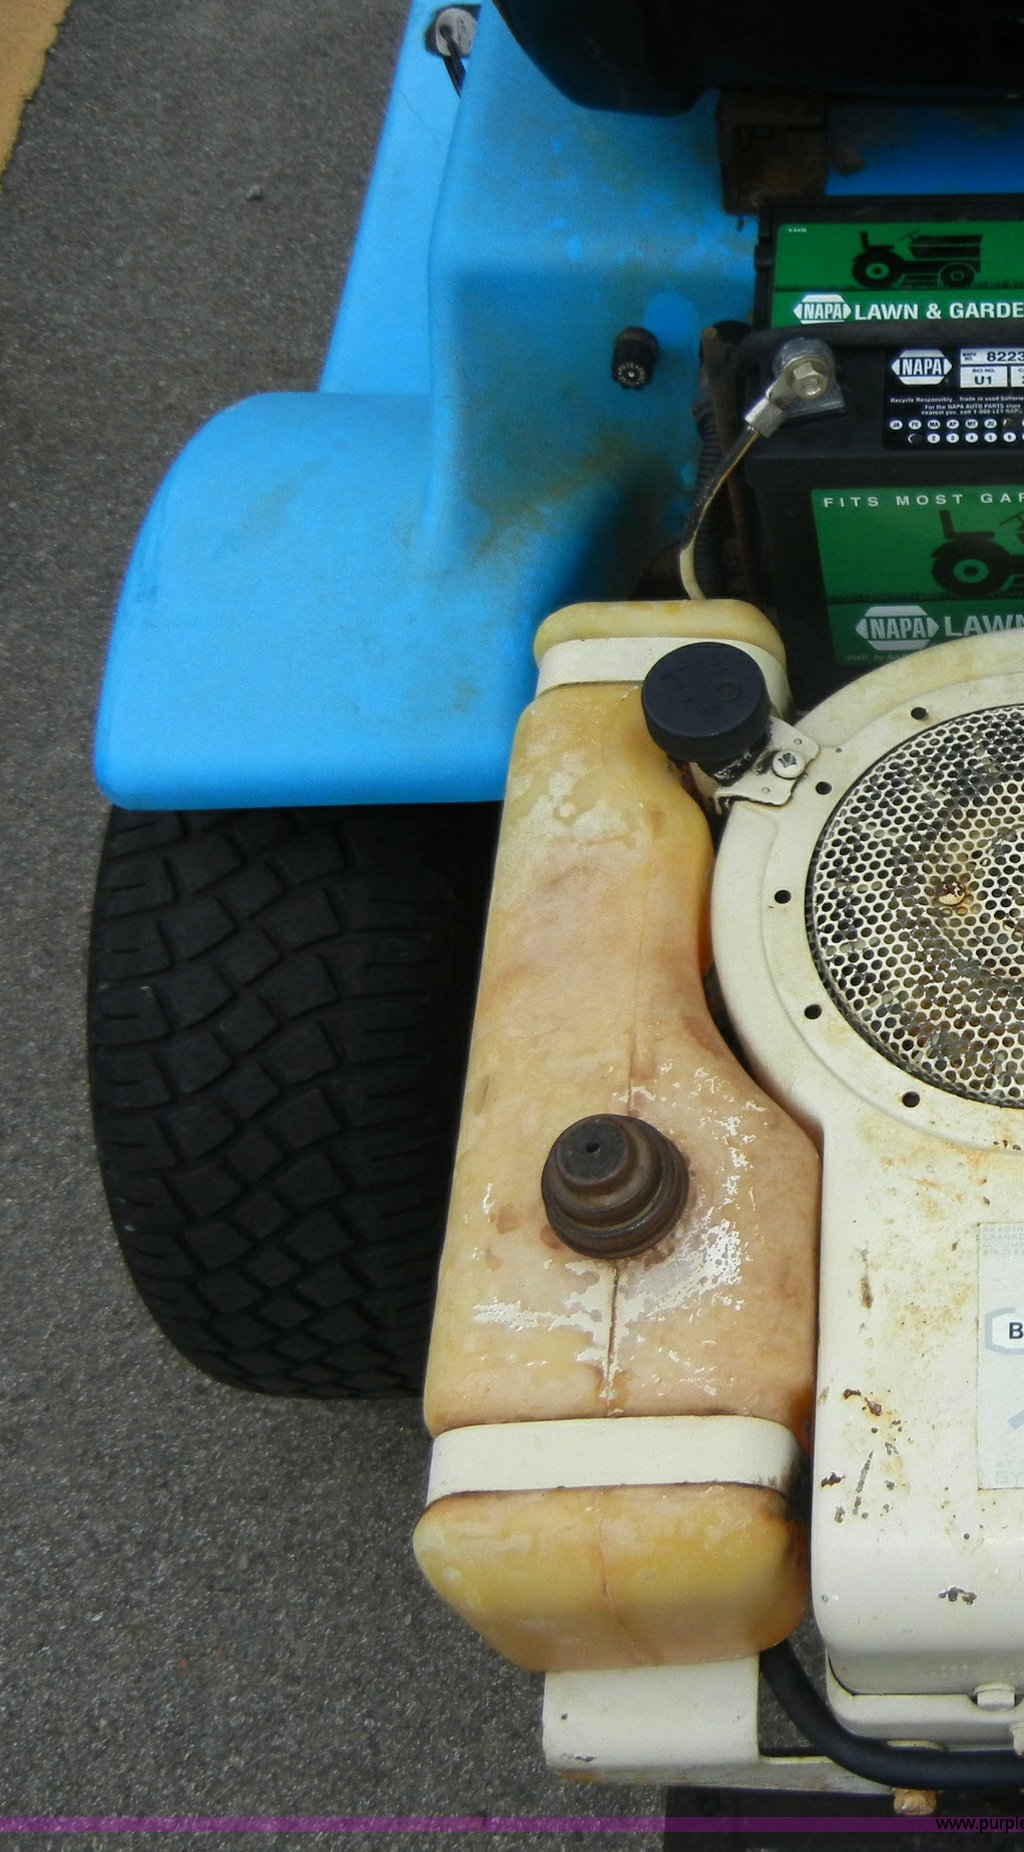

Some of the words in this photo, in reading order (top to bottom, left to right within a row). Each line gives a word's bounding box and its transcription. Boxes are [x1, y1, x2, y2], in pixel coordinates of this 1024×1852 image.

[803, 302, 842, 320] NAPA
[854, 303, 919, 320] LAWN
[926, 302, 942, 319] &
[901, 357, 942, 376] NAPA
[974, 375, 993, 385] U1
[823, 496, 880, 508] FITS
[895, 493, 965, 506] MOST
[869, 617, 927, 640] NAPA
[994, 1459, 1015, 1468] AT
